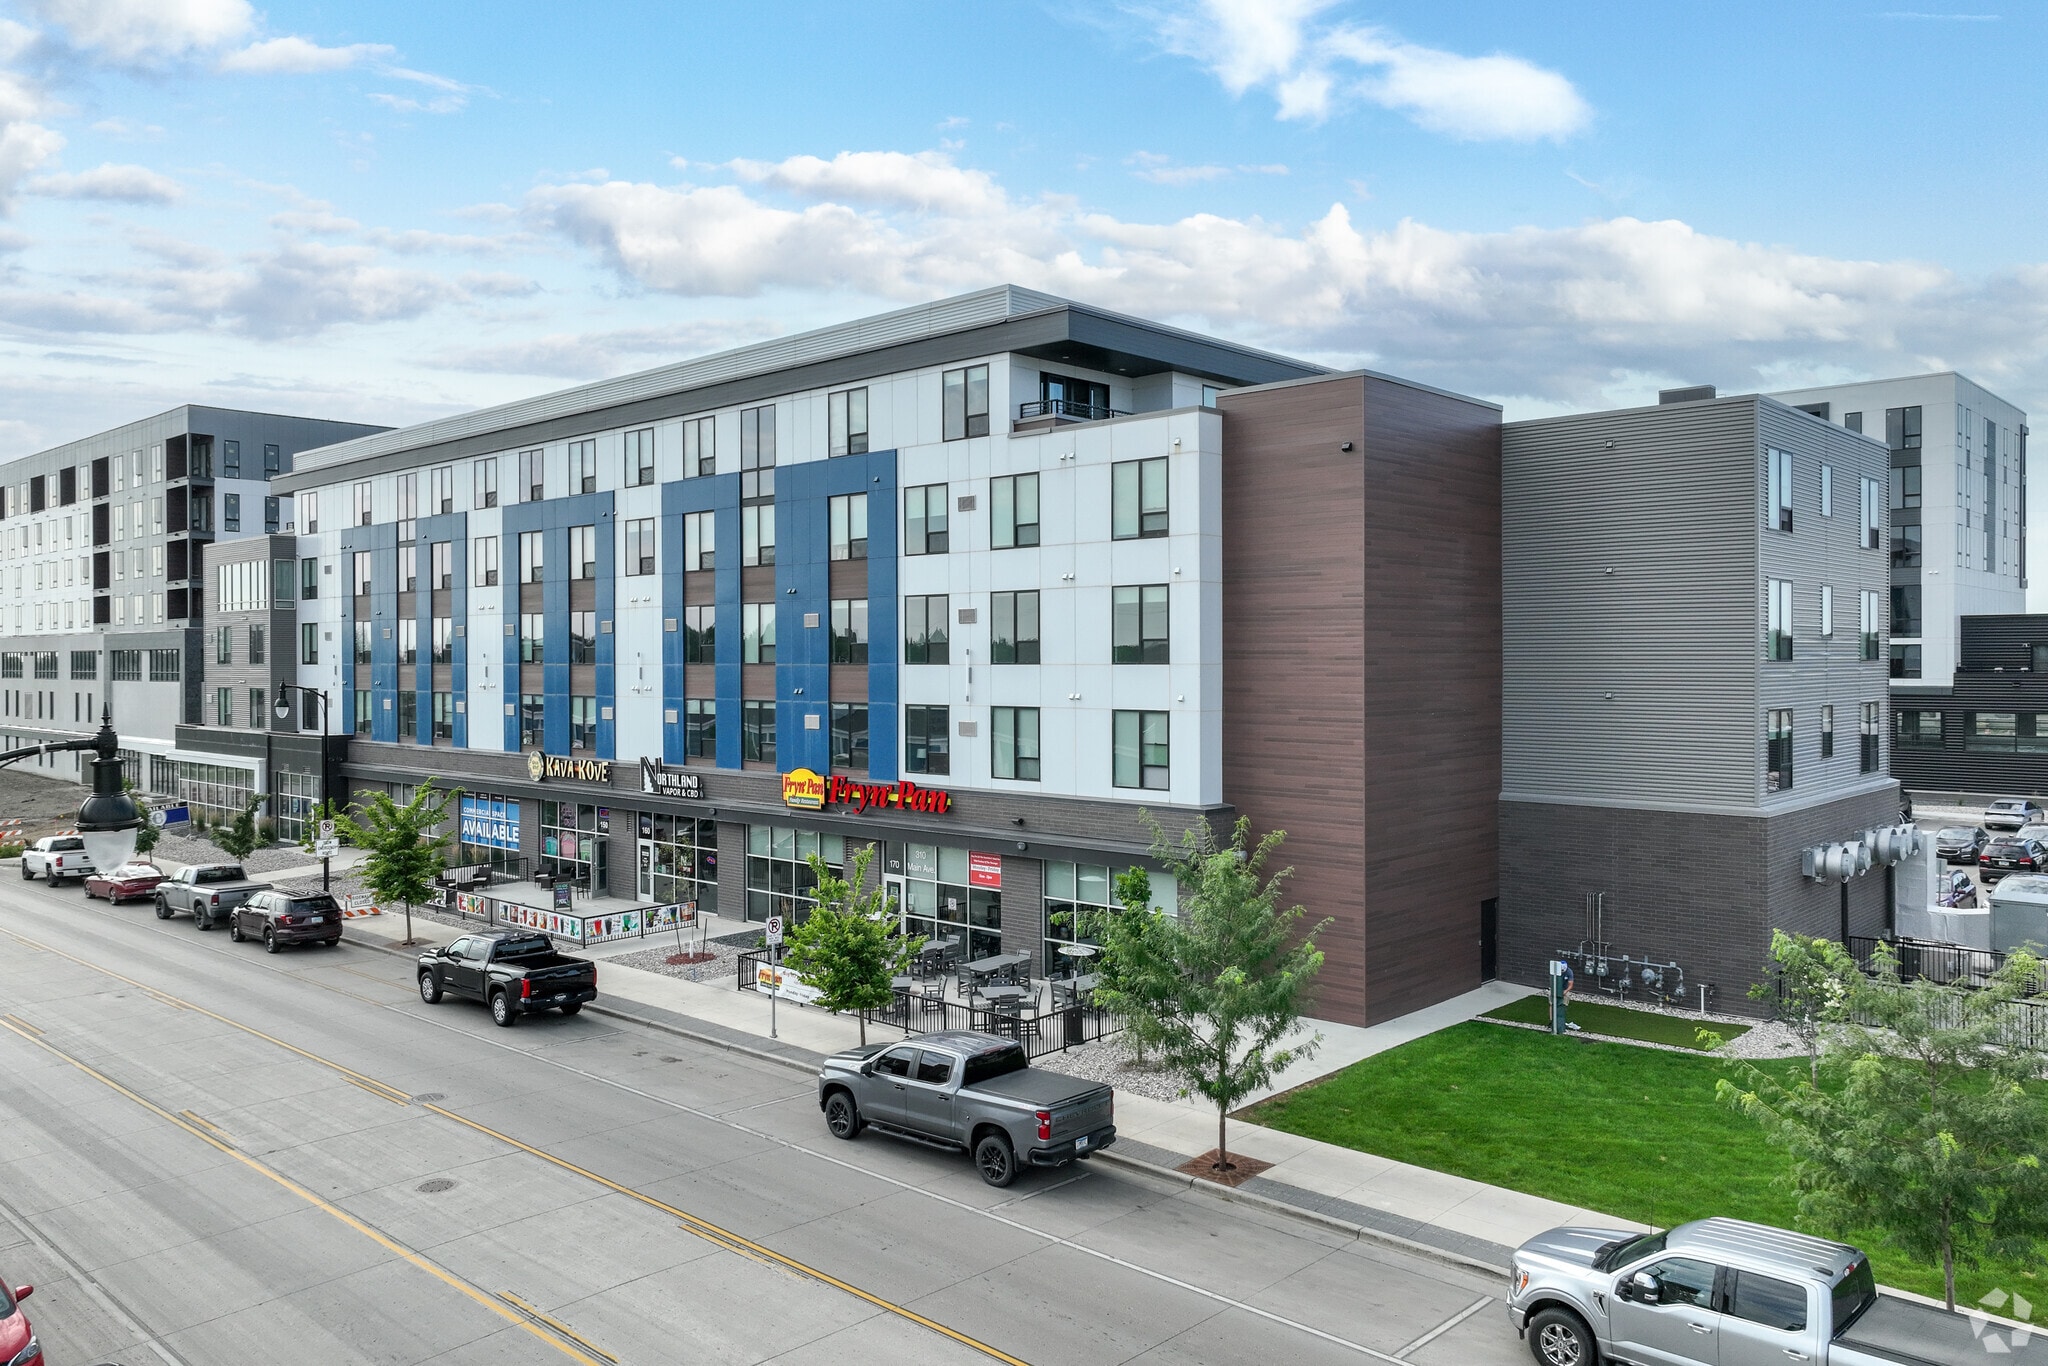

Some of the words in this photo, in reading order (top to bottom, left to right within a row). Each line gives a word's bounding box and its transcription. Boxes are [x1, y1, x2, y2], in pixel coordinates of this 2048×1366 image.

[546, 757, 574, 778] KAVA
[578, 759, 610, 782] KOVE
[806, 778, 824, 795] Pan
[662, 787, 681, 797] VAPOR
[681, 789, 686, 797] &
[687, 789, 699, 798] CBD
[828, 775, 894, 814] Fryn'
[896, 780, 950, 814] Pan
[463, 807, 490, 816] COMMERCIA
[462, 819, 520, 842] AVAILABLE
[915, 850, 927, 860] 310
[889, 860, 900, 869] 170
[907, 862, 922, 872] Main
[352, 893, 372, 901] SIDEWAL
